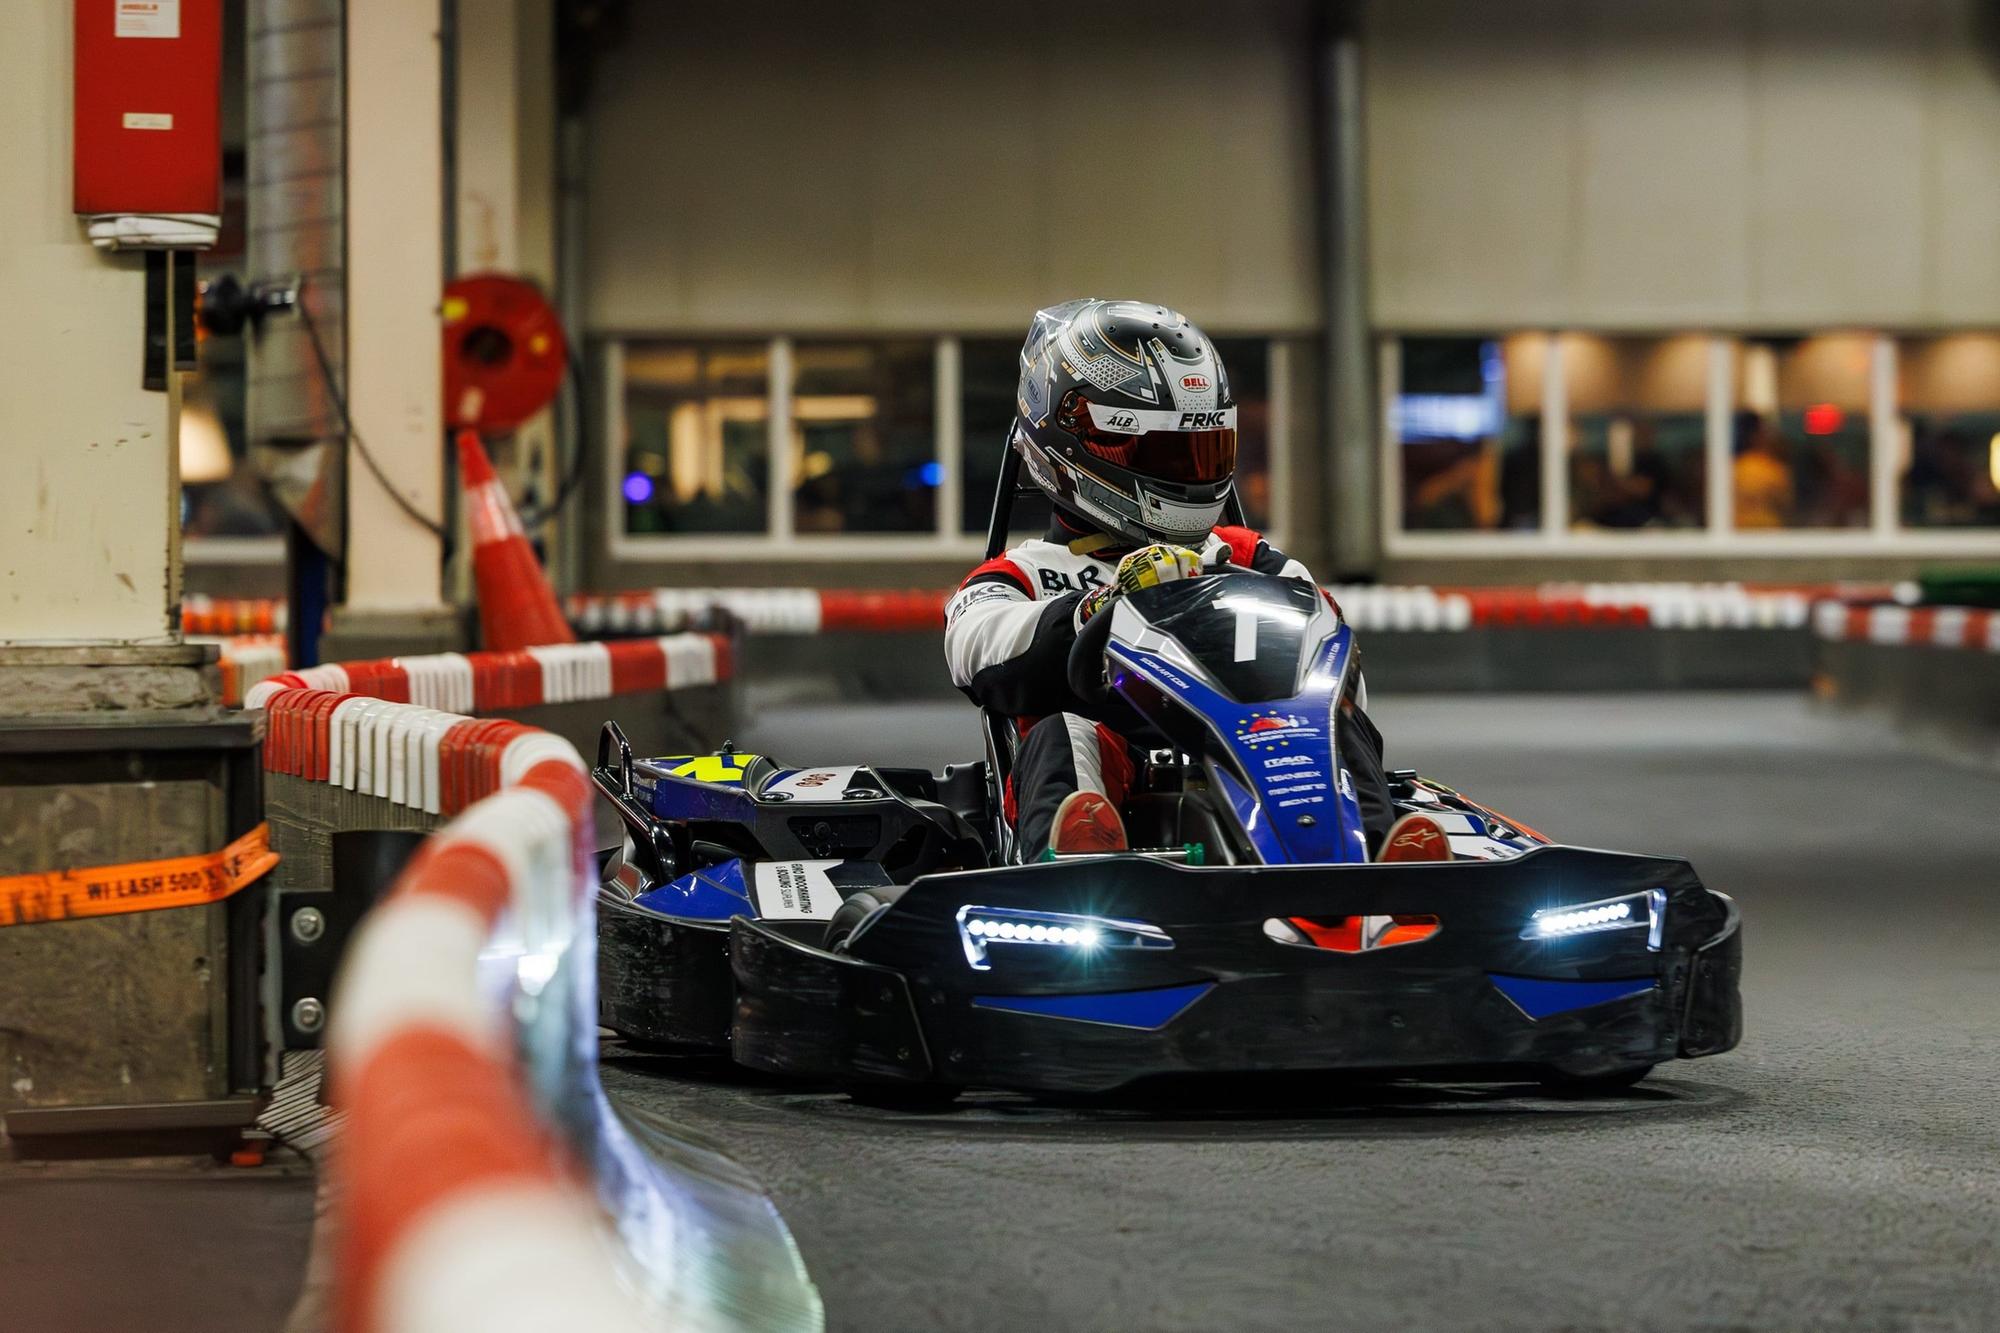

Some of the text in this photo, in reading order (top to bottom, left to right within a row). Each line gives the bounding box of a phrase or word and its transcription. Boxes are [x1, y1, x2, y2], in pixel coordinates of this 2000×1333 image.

[1183, 377, 1209, 387] BELL
[1107, 416, 1133, 427] ALB
[1179, 411, 1225, 427] FRKC
